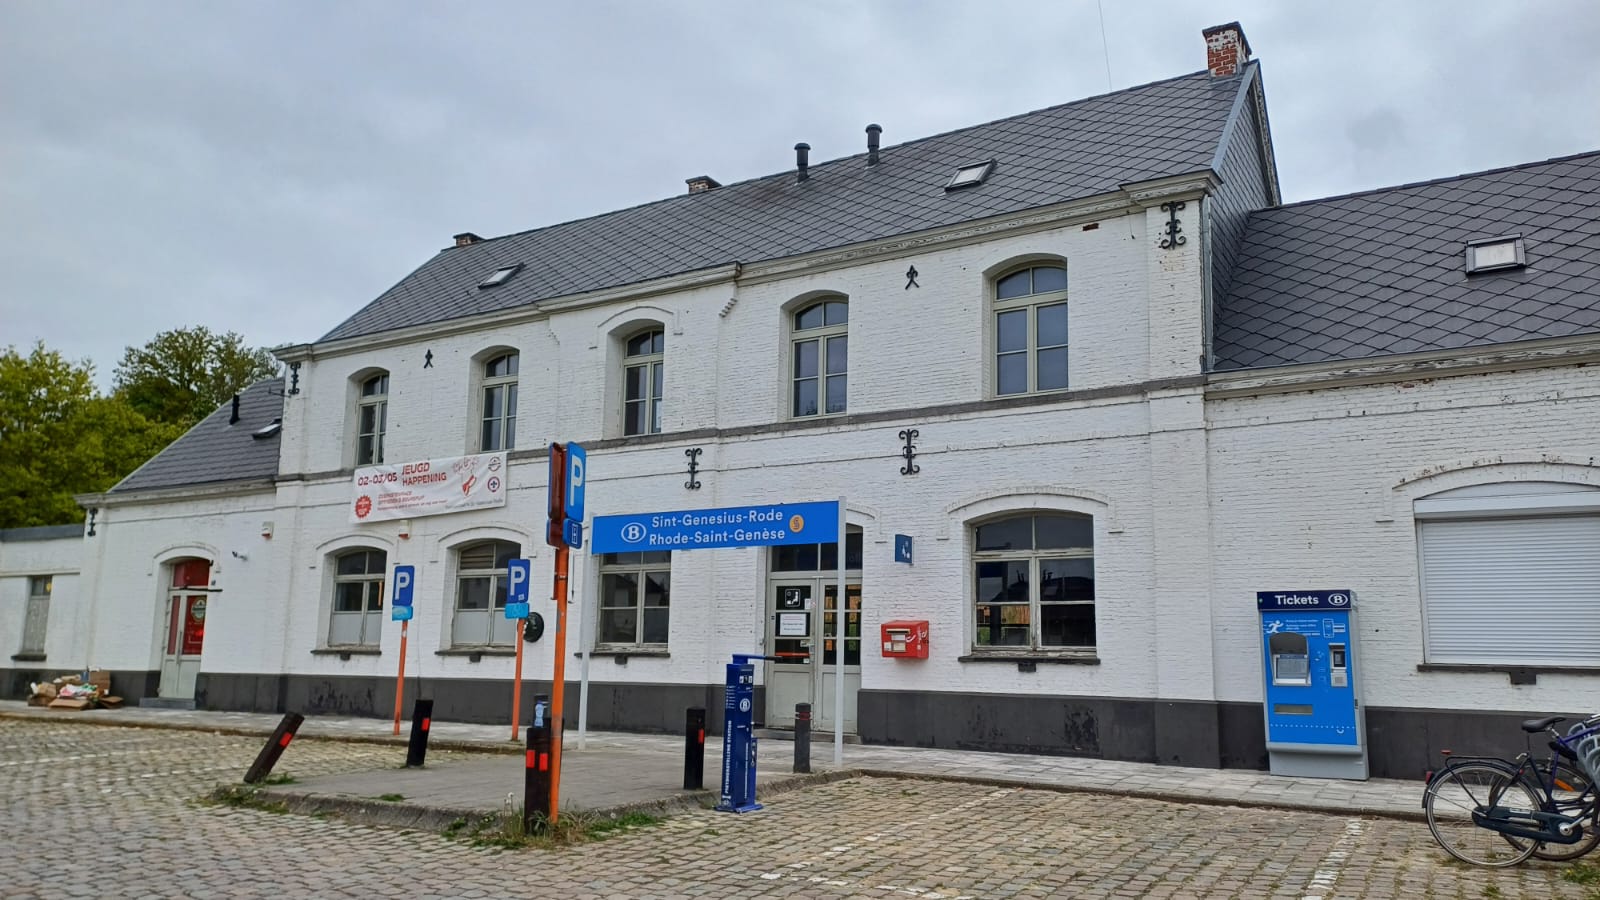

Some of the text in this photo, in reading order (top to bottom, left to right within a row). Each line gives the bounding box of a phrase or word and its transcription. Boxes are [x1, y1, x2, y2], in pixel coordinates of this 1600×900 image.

[401, 462, 430, 476] JEUGD
[358, 472, 398, 487] 02-03/05
[402, 472, 447, 487] HAPPENING
[569, 455, 584, 506] P
[651, 509, 784, 528] Sint-Genesius-Rode
[649, 528, 786, 546] Rhode-Saint-Genèse
[394, 572, 410, 600] P
[510, 566, 526, 596] P
[1274, 594, 1320, 605] Tickets
